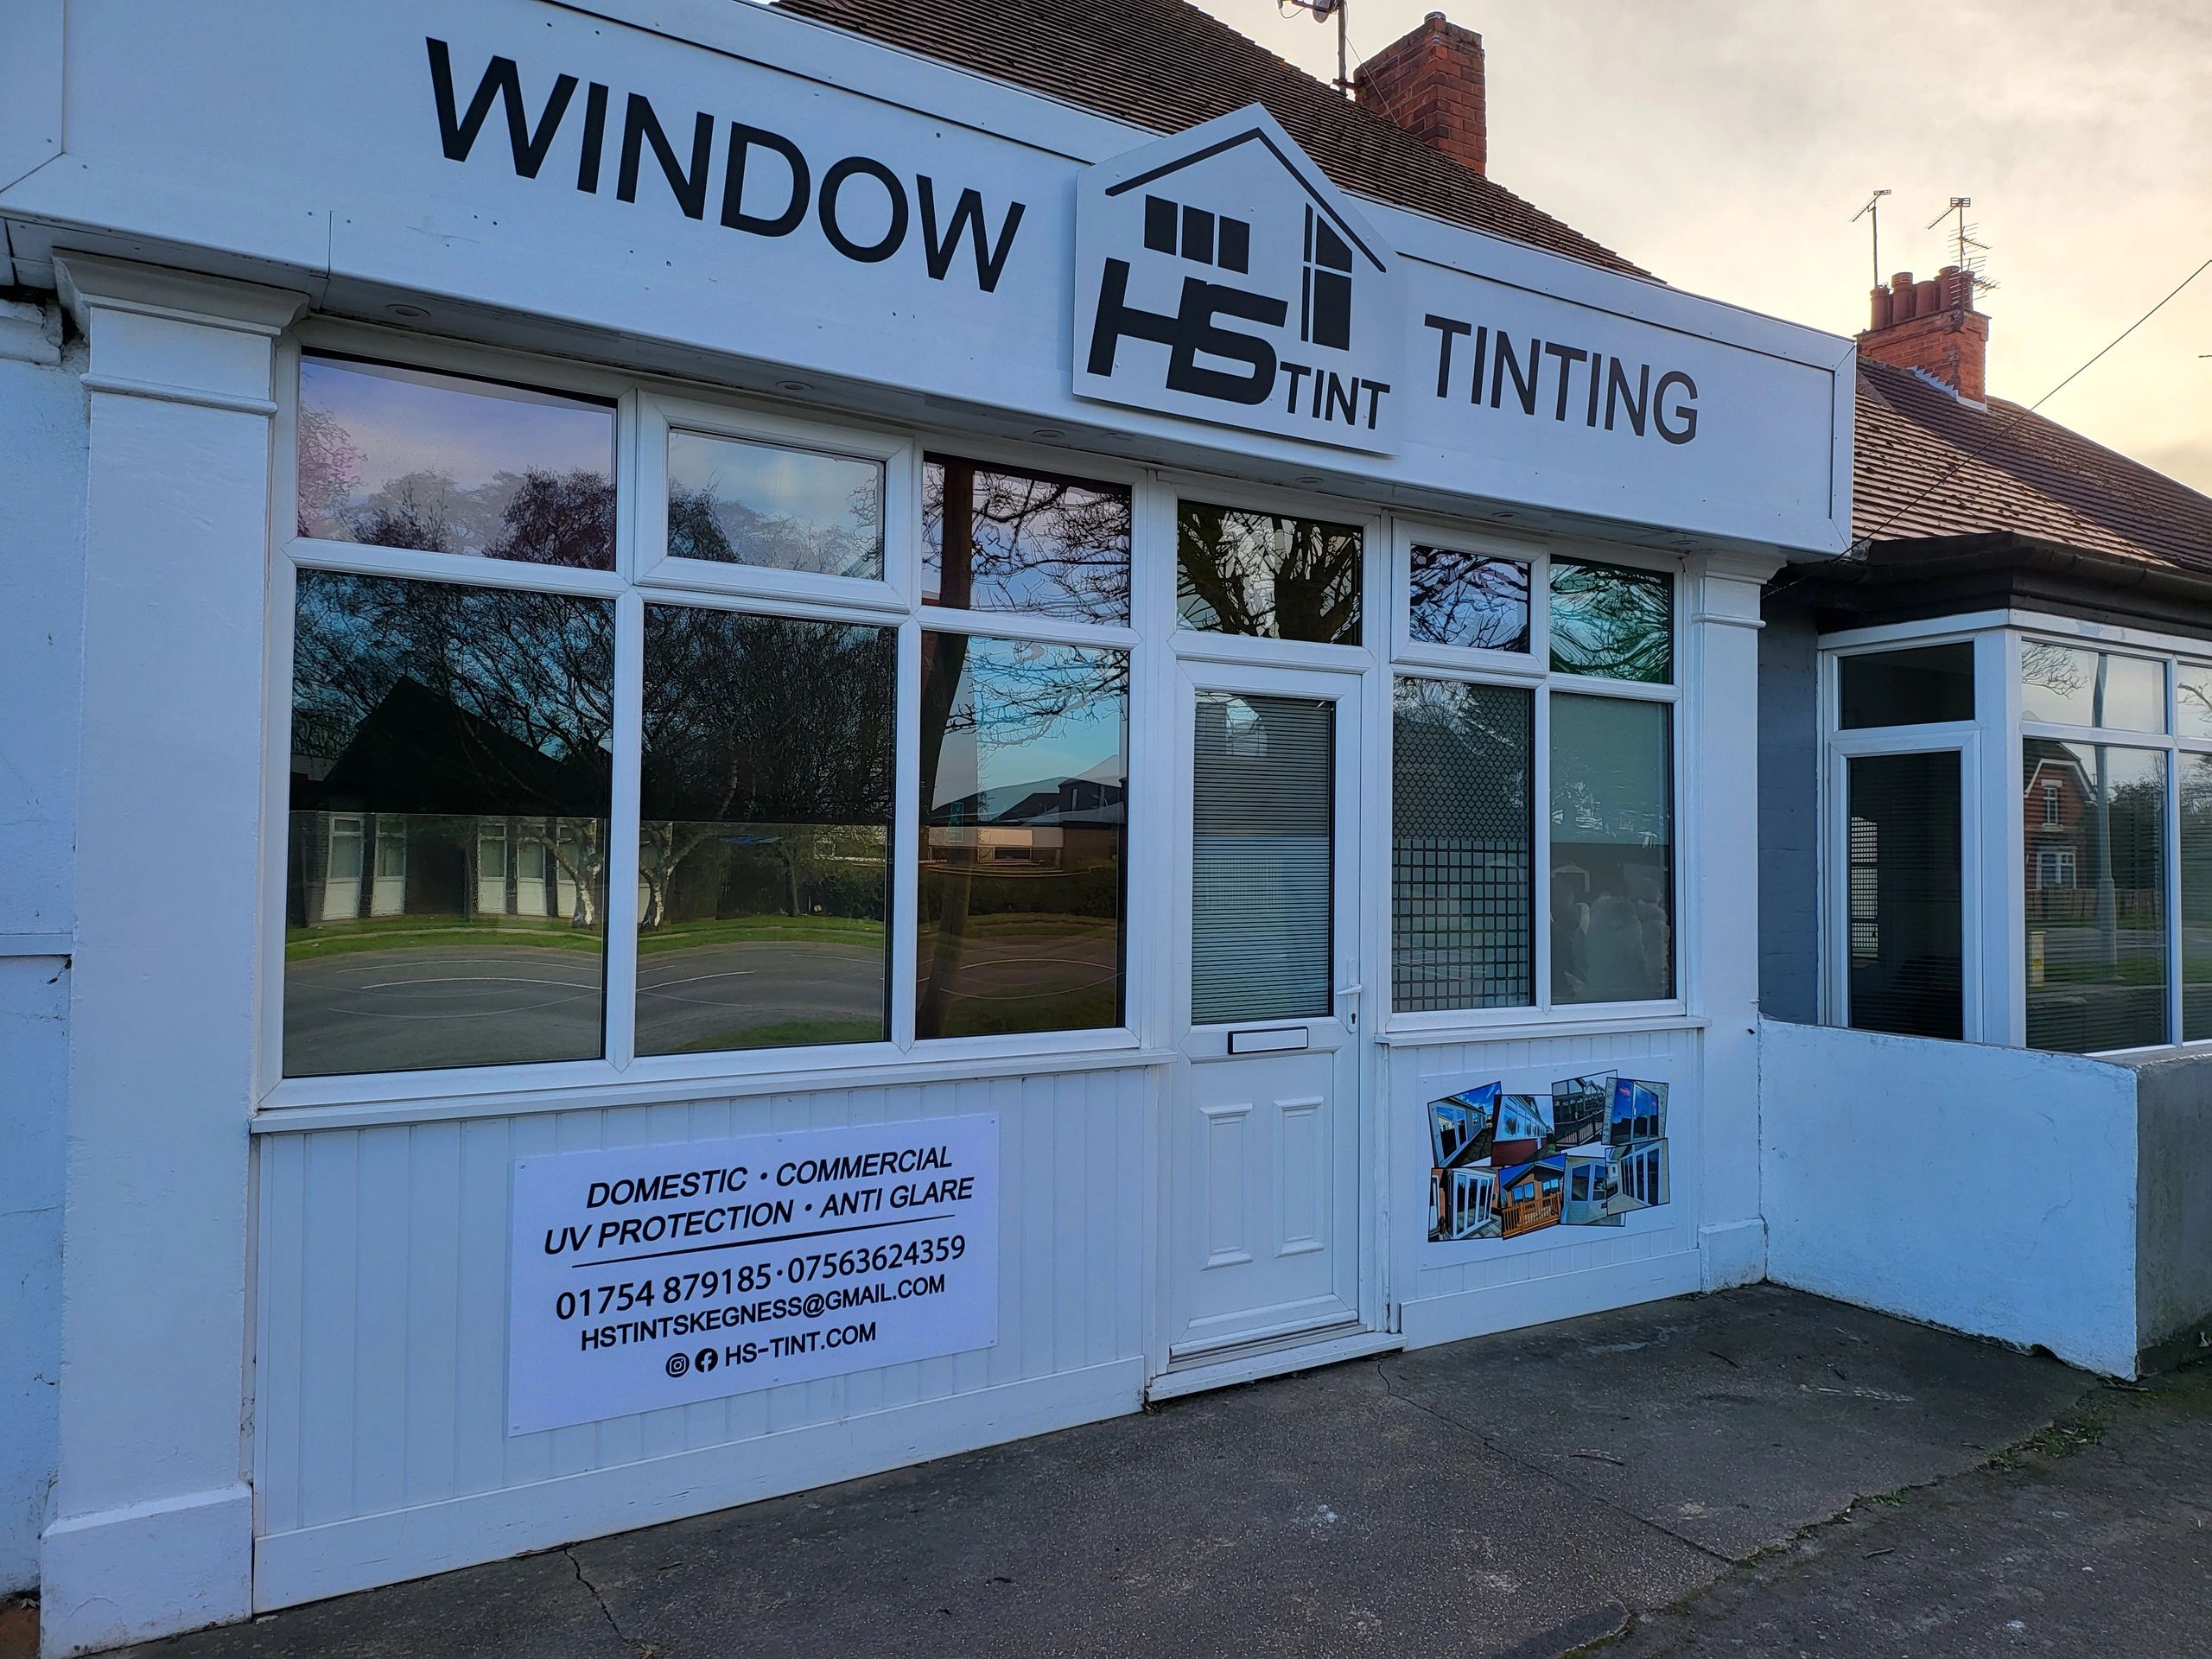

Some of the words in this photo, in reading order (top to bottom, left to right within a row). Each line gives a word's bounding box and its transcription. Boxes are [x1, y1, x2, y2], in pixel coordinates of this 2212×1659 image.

[425, 35, 1027, 294] WINDOW
[1423, 313, 1698, 445] TINTING
[1086, 257, 1289, 405] HS
[1279, 360, 1391, 430] TINT
[544, 1224, 594, 1255] UV
[597, 1198, 795, 1249] PROTECTION
[818, 1187, 883, 1219] ANTI
[889, 1176, 976, 1209] GLARE
[586, 1166, 748, 1210] DOMESTIC
[776, 1145, 953, 1187] COMMERCIAL
[556, 1279, 656, 1320] 01754
[663, 1262, 772, 1304] 879185
[787, 1234, 966, 1284] 07563624359
[581, 1273, 945, 1352] HSTINTSKEGNESS@GMAIL.COM
[725, 1321, 876, 1368] HS-TINT.COM
